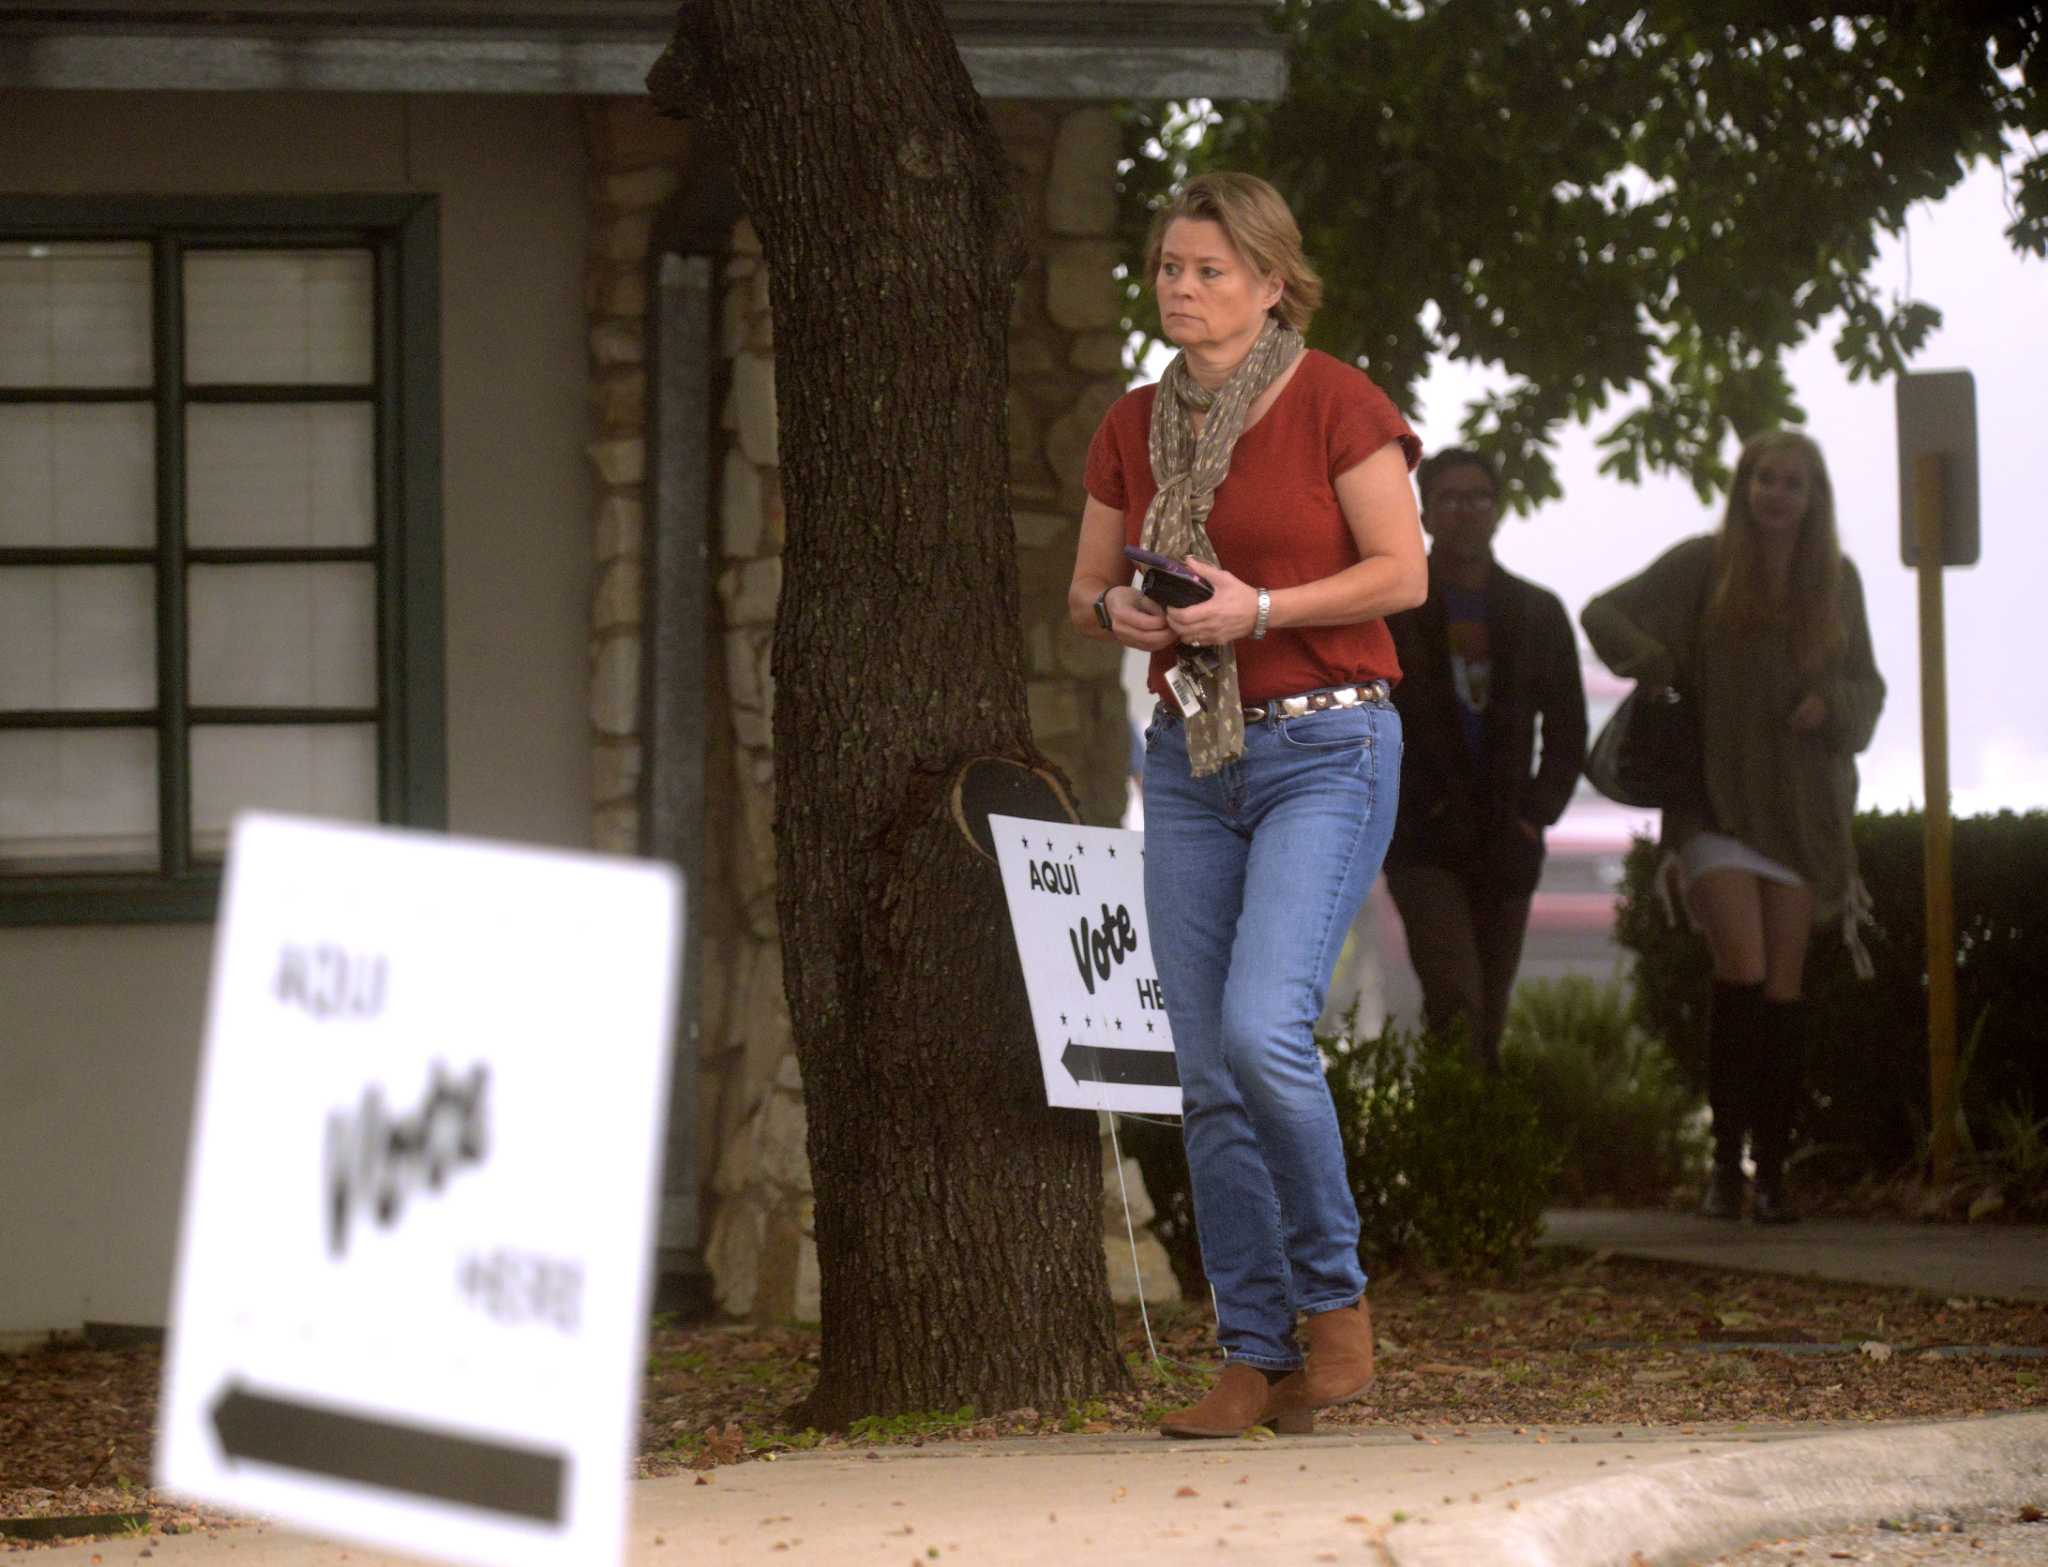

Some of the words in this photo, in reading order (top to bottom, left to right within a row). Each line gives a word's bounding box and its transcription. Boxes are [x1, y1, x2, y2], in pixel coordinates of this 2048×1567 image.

[1030, 854, 1080, 895] AQUÍ
[1069, 903, 1137, 995] Vote
[1136, 978, 1165, 1010] HE
